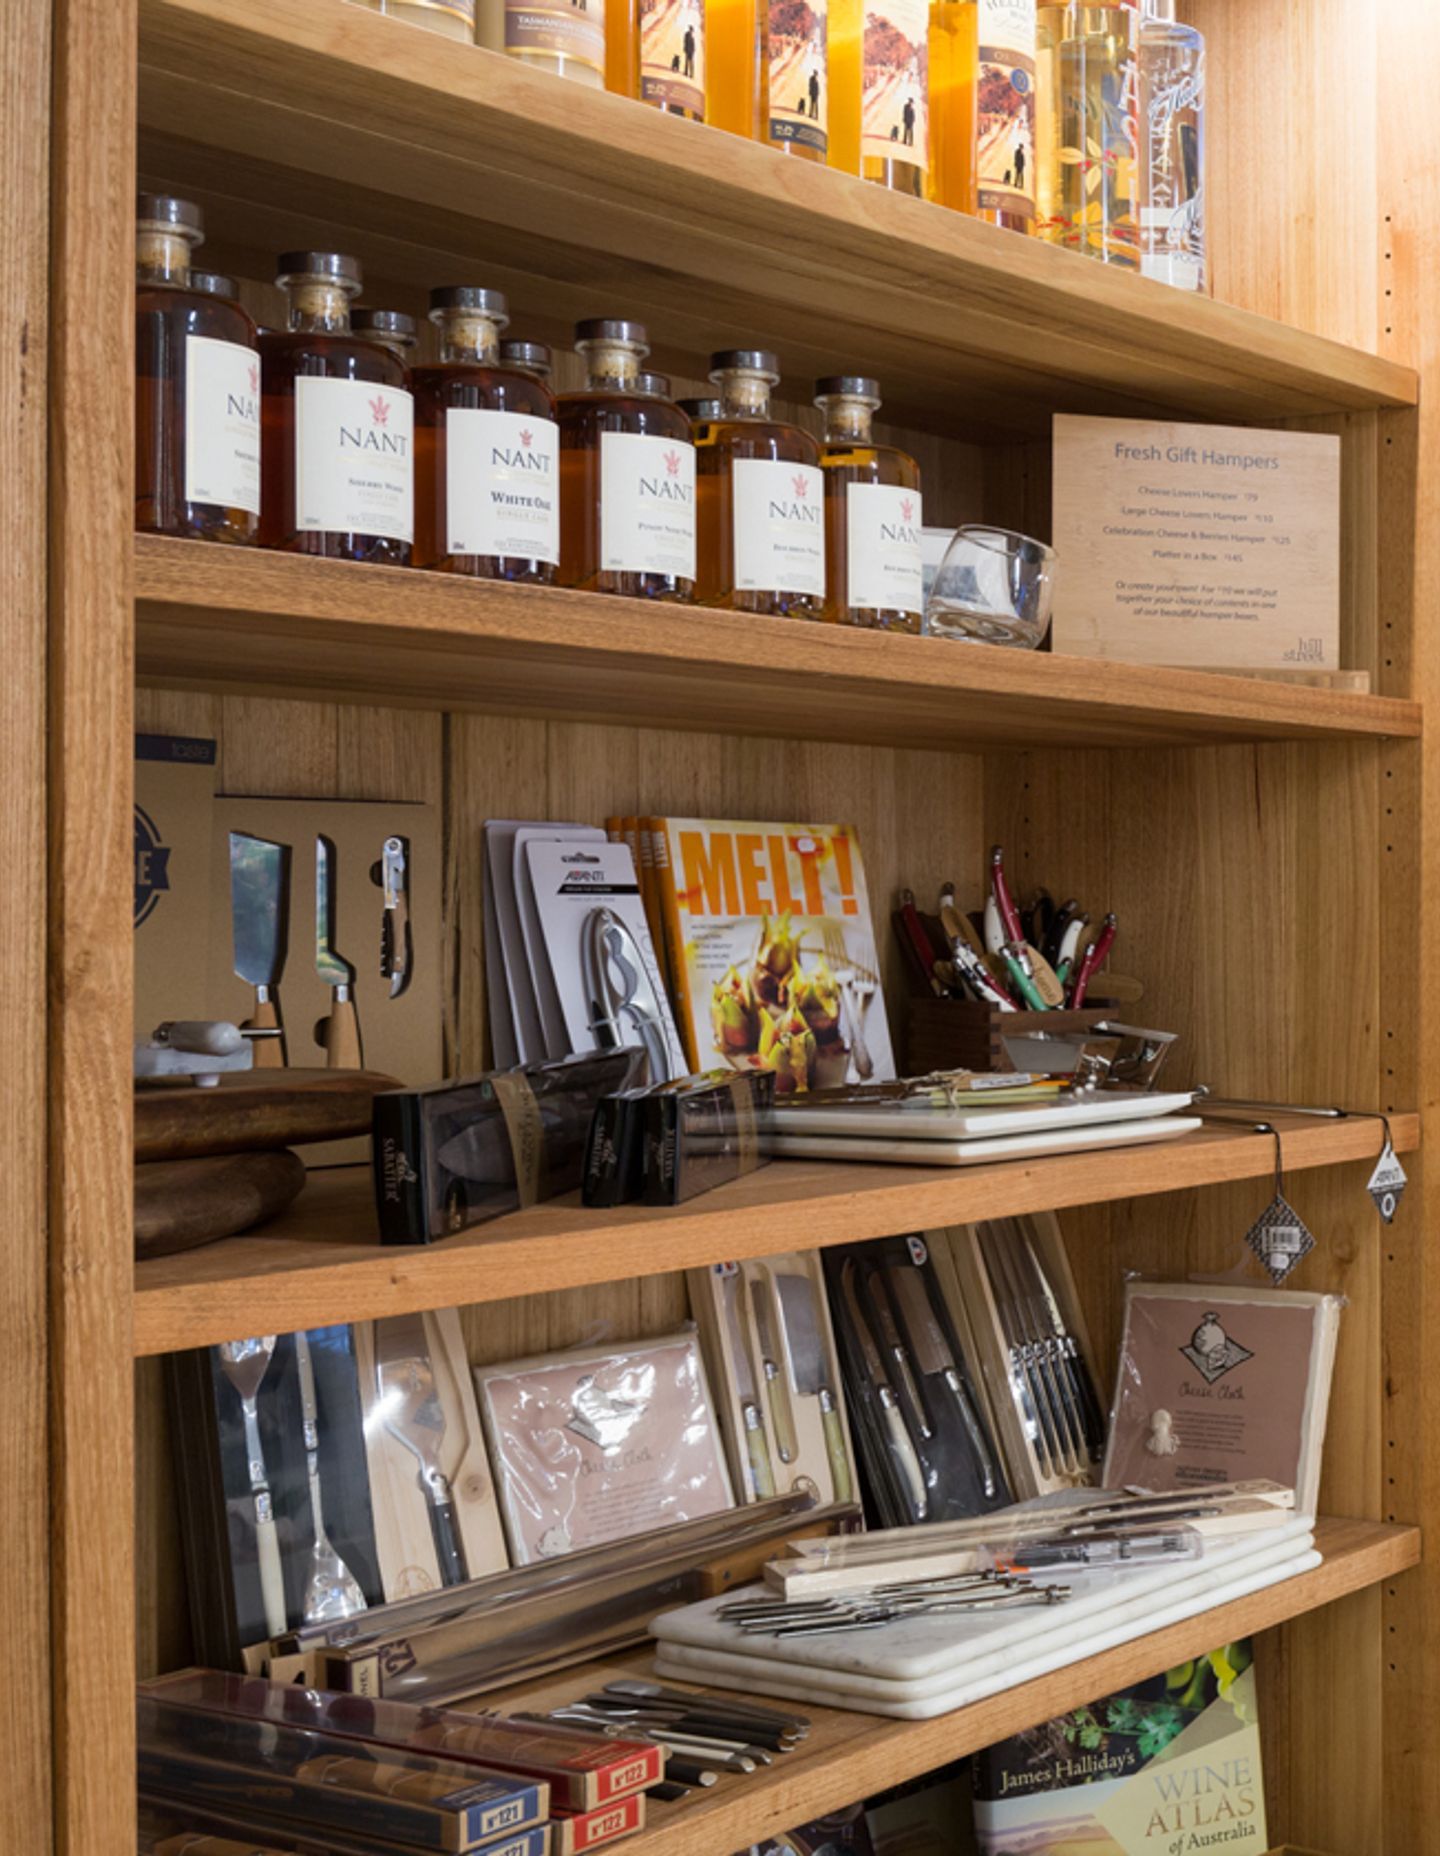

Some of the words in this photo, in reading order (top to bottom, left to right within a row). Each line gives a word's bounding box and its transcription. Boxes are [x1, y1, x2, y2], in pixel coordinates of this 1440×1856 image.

[339, 425, 408, 457] NANT
[491, 447, 551, 473] NANT
[1114, 442, 1162, 462] Fresh
[1166, 445, 1198, 464] Gift
[1201, 449, 1280, 471] Hampers
[490, 490, 533, 508] WHITE
[1138, 485, 1171, 497] Cheese
[1201, 490, 1238, 501] Hamper
[769, 500, 821, 527] NANT
[1121, 505, 1147, 517] Large
[1150, 507, 1181, 518] Cheese
[1213, 511, 1248, 522] Hamper
[1102, 524, 1154, 537] Celebration
[1157, 527, 1190, 539] Cheese
[1190, 530, 1198, 540] &
[1230, 533, 1266, 545] Hamper
[1183, 551, 1193, 560] in
[678, 831, 860, 916] MELT!
[382, 1137, 400, 1203] SABATIER
[1178, 1381, 1214, 1398] Cheese
[1217, 1383, 1246, 1400] Cloth
[999, 1766, 1052, 1794] James
[1055, 1748, 1137, 1780] Halliday's
[1153, 1757, 1253, 1802] WINE
[1145, 1786, 1257, 1838] ATLAS
[1168, 1834, 1187, 1856] of
[1186, 1822, 1257, 1851] Australia
